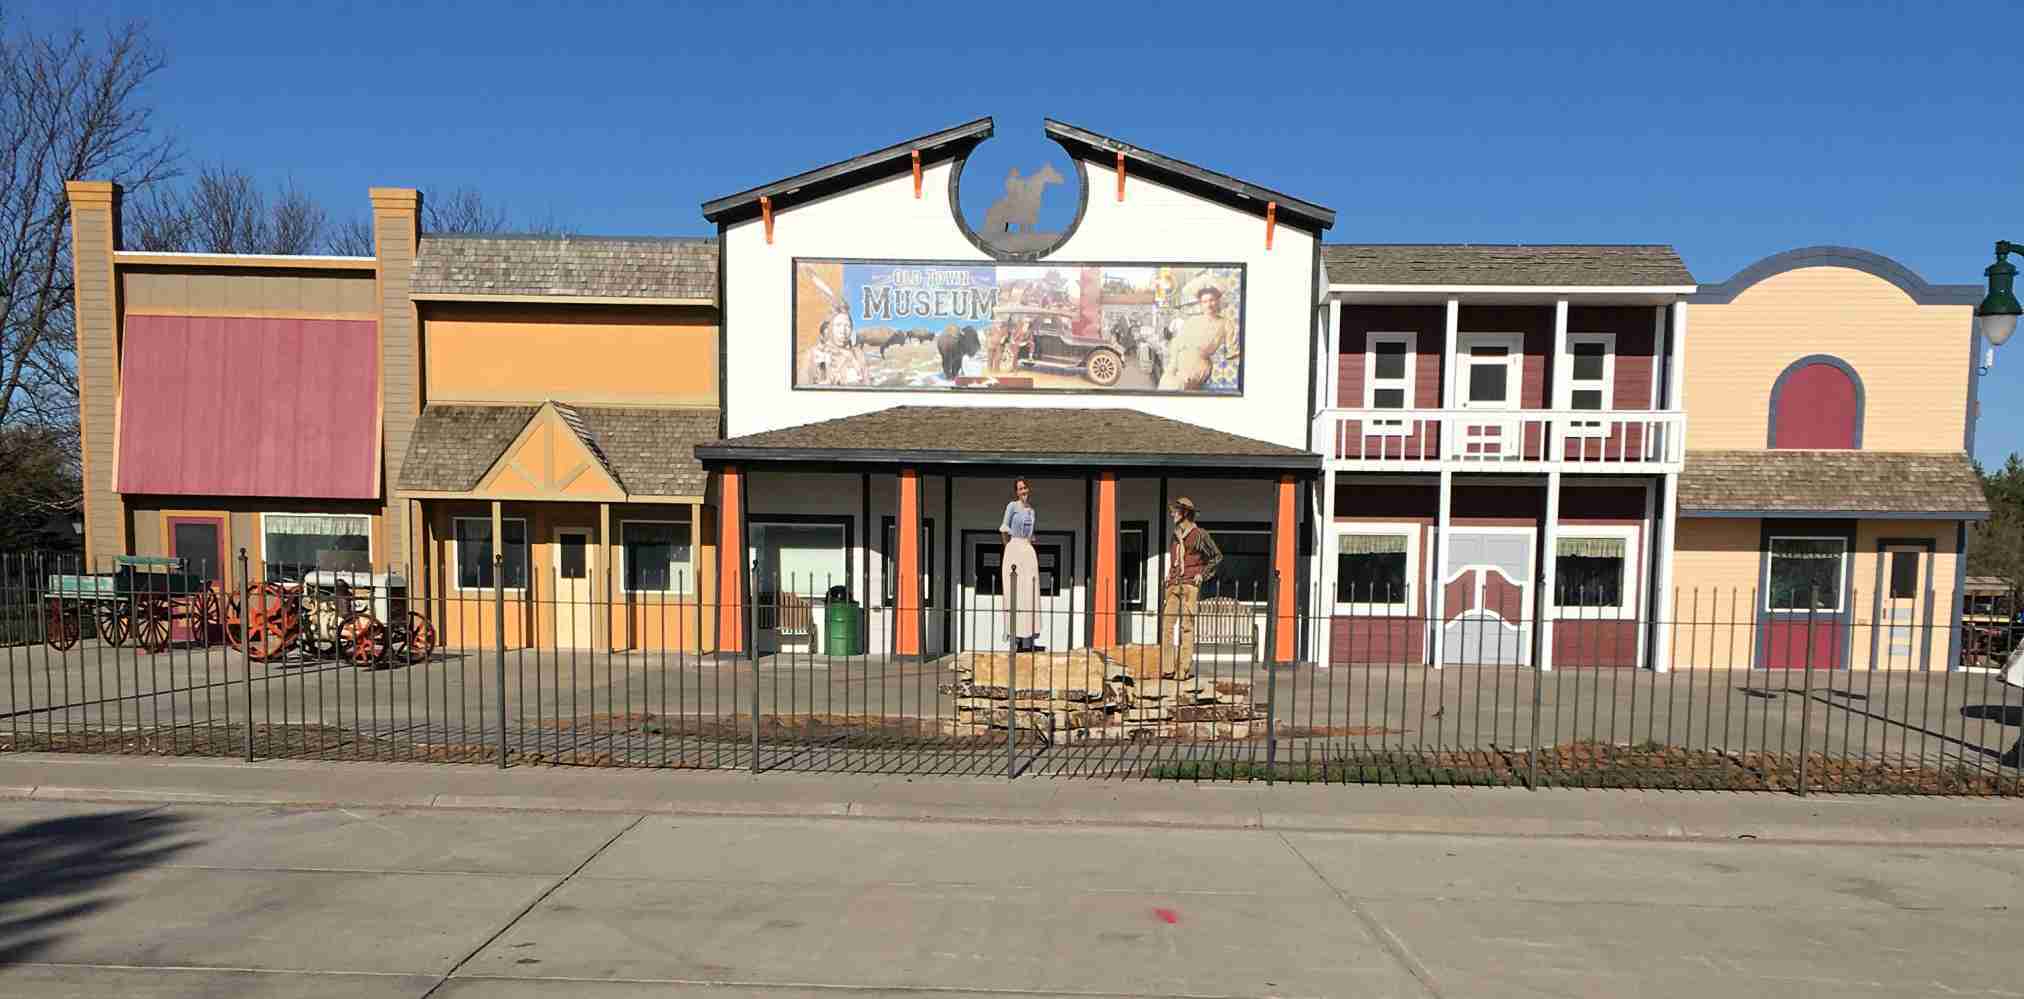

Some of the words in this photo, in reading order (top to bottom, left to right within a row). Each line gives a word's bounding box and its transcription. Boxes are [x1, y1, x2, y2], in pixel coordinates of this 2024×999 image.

[893, 270, 921, 286] OLD
[927, 270, 970, 286] TOWN
[863, 286, 998, 320] MUSEUM
